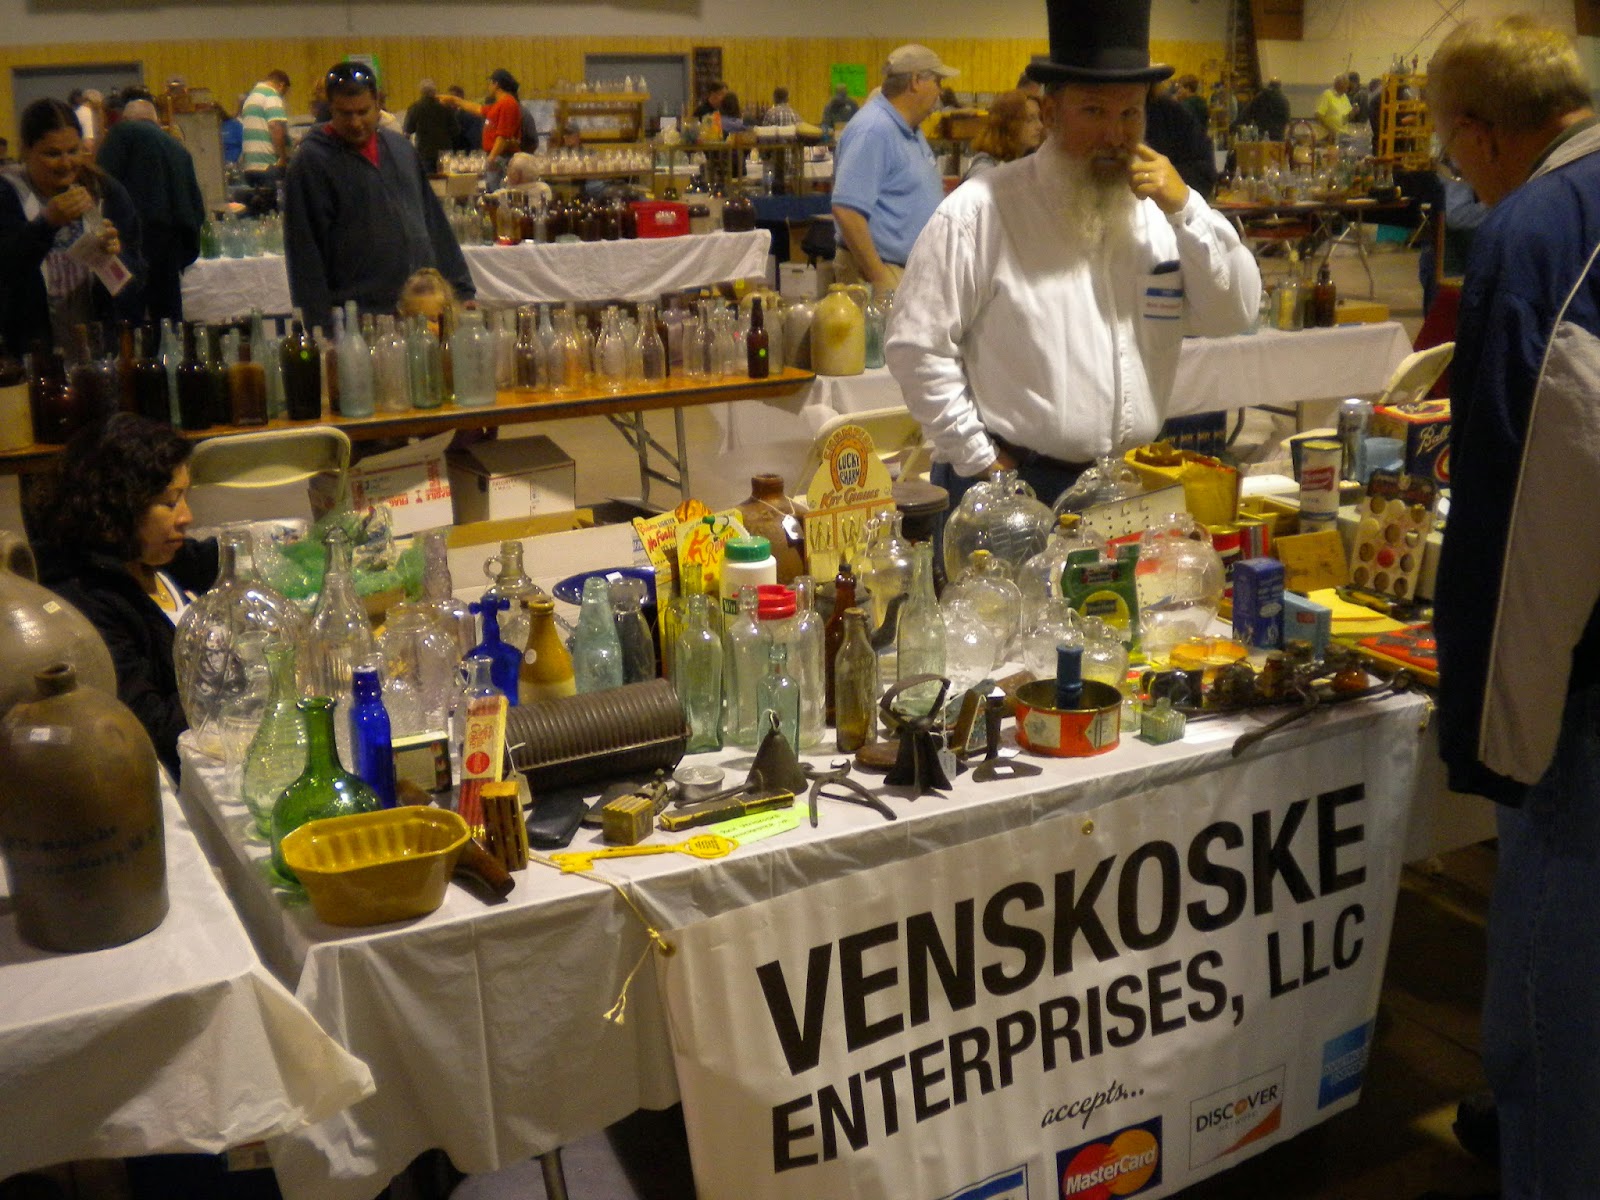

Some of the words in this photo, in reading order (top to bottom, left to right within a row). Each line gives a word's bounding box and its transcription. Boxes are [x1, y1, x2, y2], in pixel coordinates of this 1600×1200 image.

[838, 452, 860, 470] LUCKY
[839, 469, 860, 485] CHARM
[756, 782, 1366, 1076] VENSKOSKE
[772, 950, 1244, 1173] ENTERPRISES,
[1267, 903, 1366, 999] LLC
[1041, 1080, 1144, 1129] accepts...
[1196, 1085, 1278, 1132] DISCOVER
[1066, 1148, 1156, 1195] MasterCard
